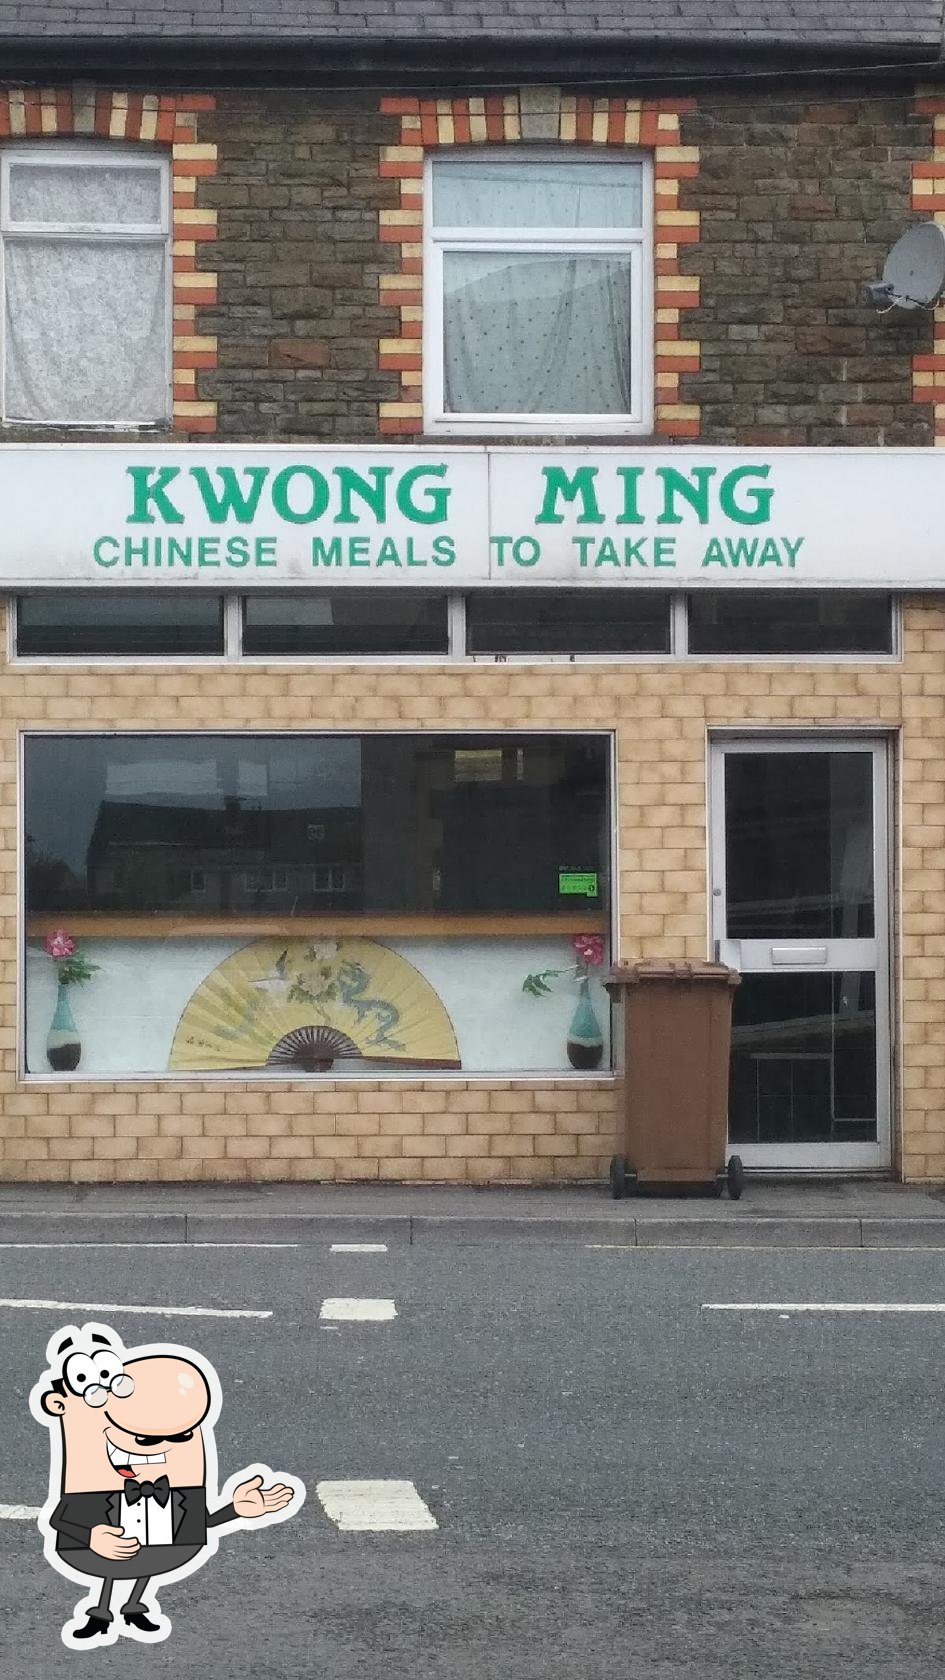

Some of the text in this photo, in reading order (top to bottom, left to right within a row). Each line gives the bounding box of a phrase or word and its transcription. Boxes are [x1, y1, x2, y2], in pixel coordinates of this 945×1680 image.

[127, 465, 775, 526] KWONG MING
[94, 535, 805, 568] CHINESE MEALS TO TAKE AWAY
